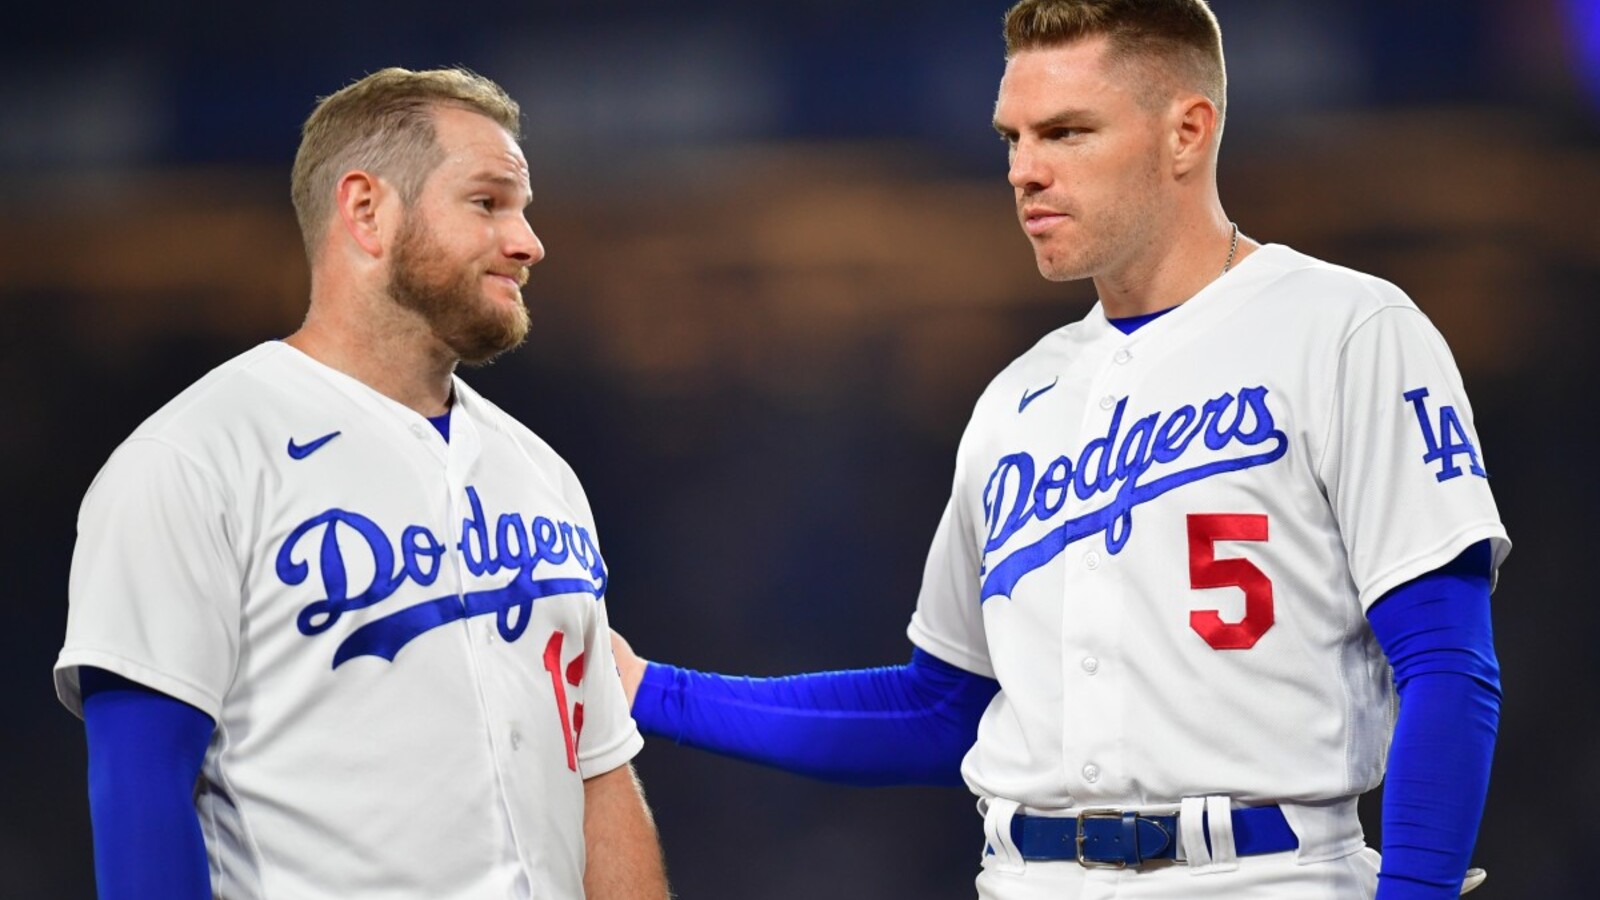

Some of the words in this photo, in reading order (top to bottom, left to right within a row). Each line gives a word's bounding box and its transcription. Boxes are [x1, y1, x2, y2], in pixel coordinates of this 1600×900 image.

[980, 386, 1287, 576] Dodgers
[1403, 387, 1488, 482] LA
[276, 486, 608, 642] Dodgers
[1186, 513, 1275, 650] 5
